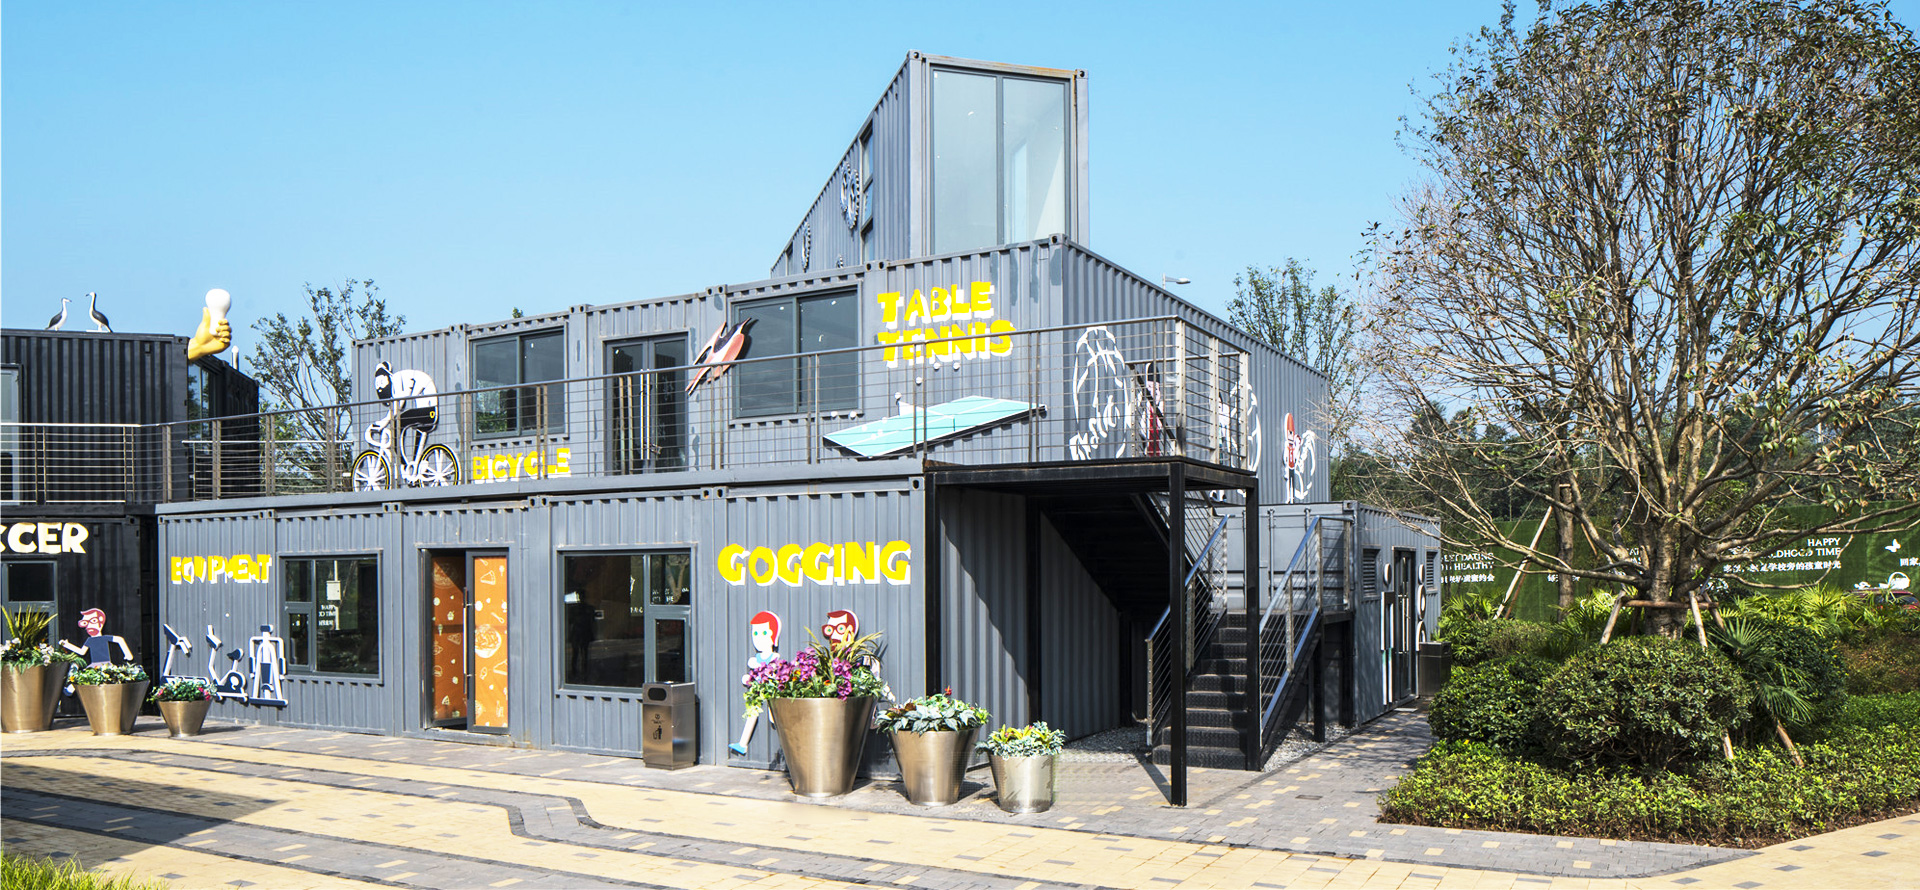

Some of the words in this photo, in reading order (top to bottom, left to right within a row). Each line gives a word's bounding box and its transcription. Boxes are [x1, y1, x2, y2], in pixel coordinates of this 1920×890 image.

[877, 281, 995, 329] TABLE
[877, 319, 1016, 368] TENNIS
[473, 448, 571, 484] BICYCLE
[1, 522, 89, 554] CER
[1807, 537, 1841, 546] HAPPY
[1462, 552, 1494, 561] DATING
[1815, 547, 1841, 556] TIME
[1899, 557, 1920, 567] 回家
[717, 540, 911, 587] GOGGING
[1454, 561, 1494, 571] HEALTHY
